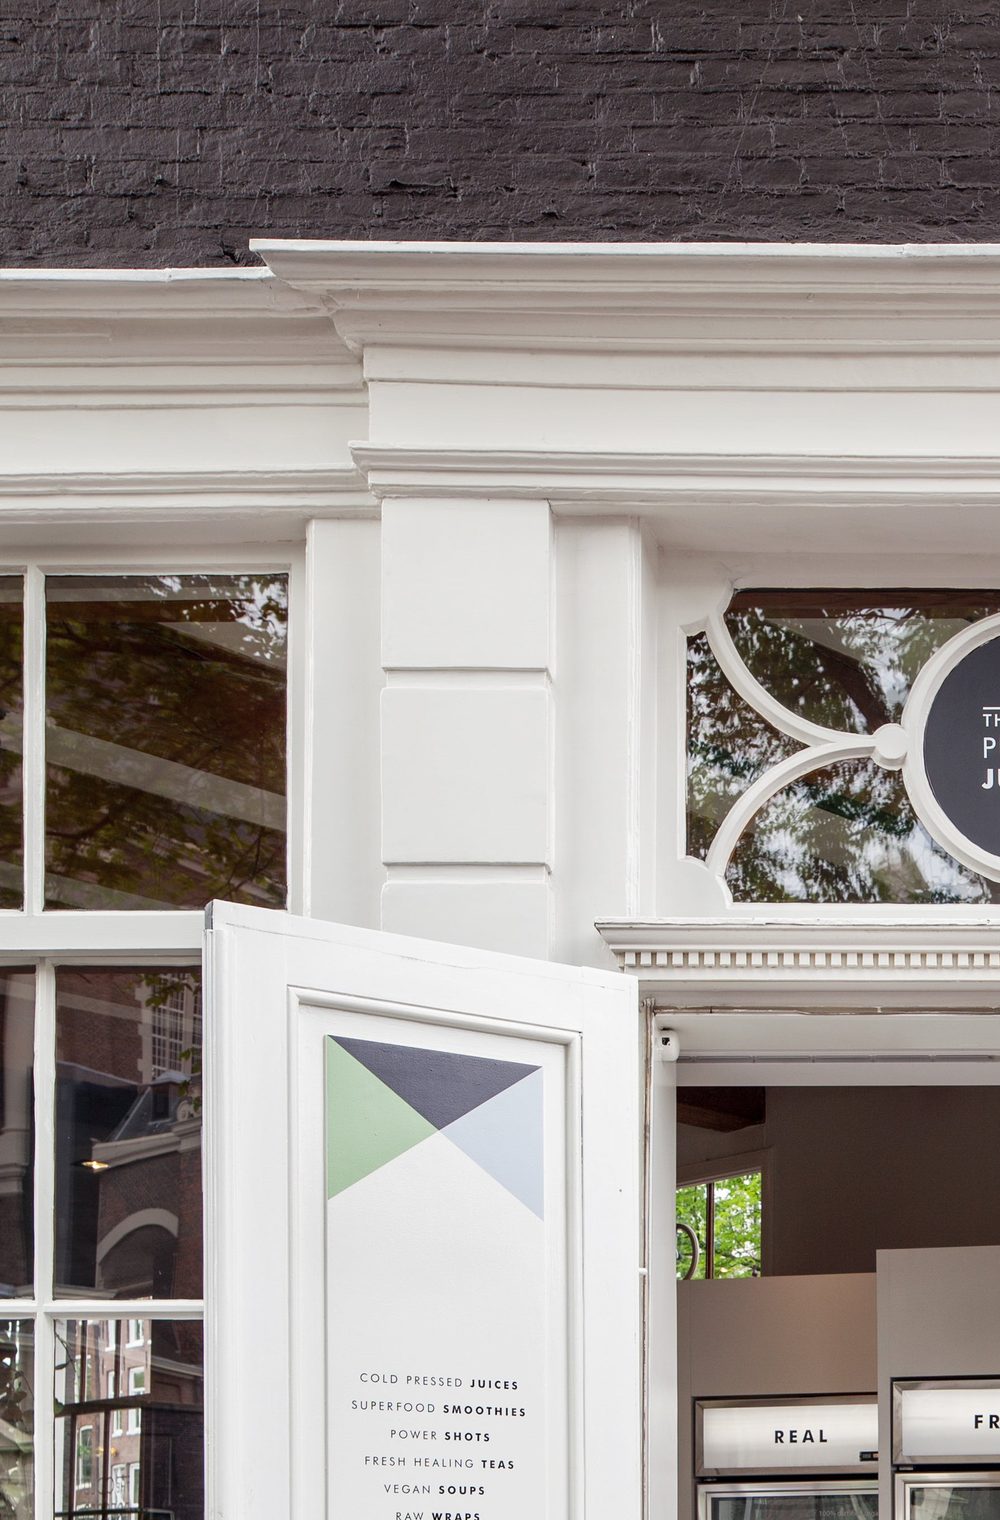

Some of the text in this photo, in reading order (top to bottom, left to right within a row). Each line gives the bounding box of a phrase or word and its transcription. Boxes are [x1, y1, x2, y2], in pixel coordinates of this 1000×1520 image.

[359, 1372, 518, 1391] COLD PRESSED JUICES
[351, 1400, 526, 1418] SUPERFOOD SMOOTHIES
[390, 1429, 490, 1443] POWER SHOTS
[773, 1429, 828, 1444] REAL
[364, 1456, 515, 1470] FRESH HEALING TEAS
[383, 1484, 485, 1496] VEGAN SOUPS
